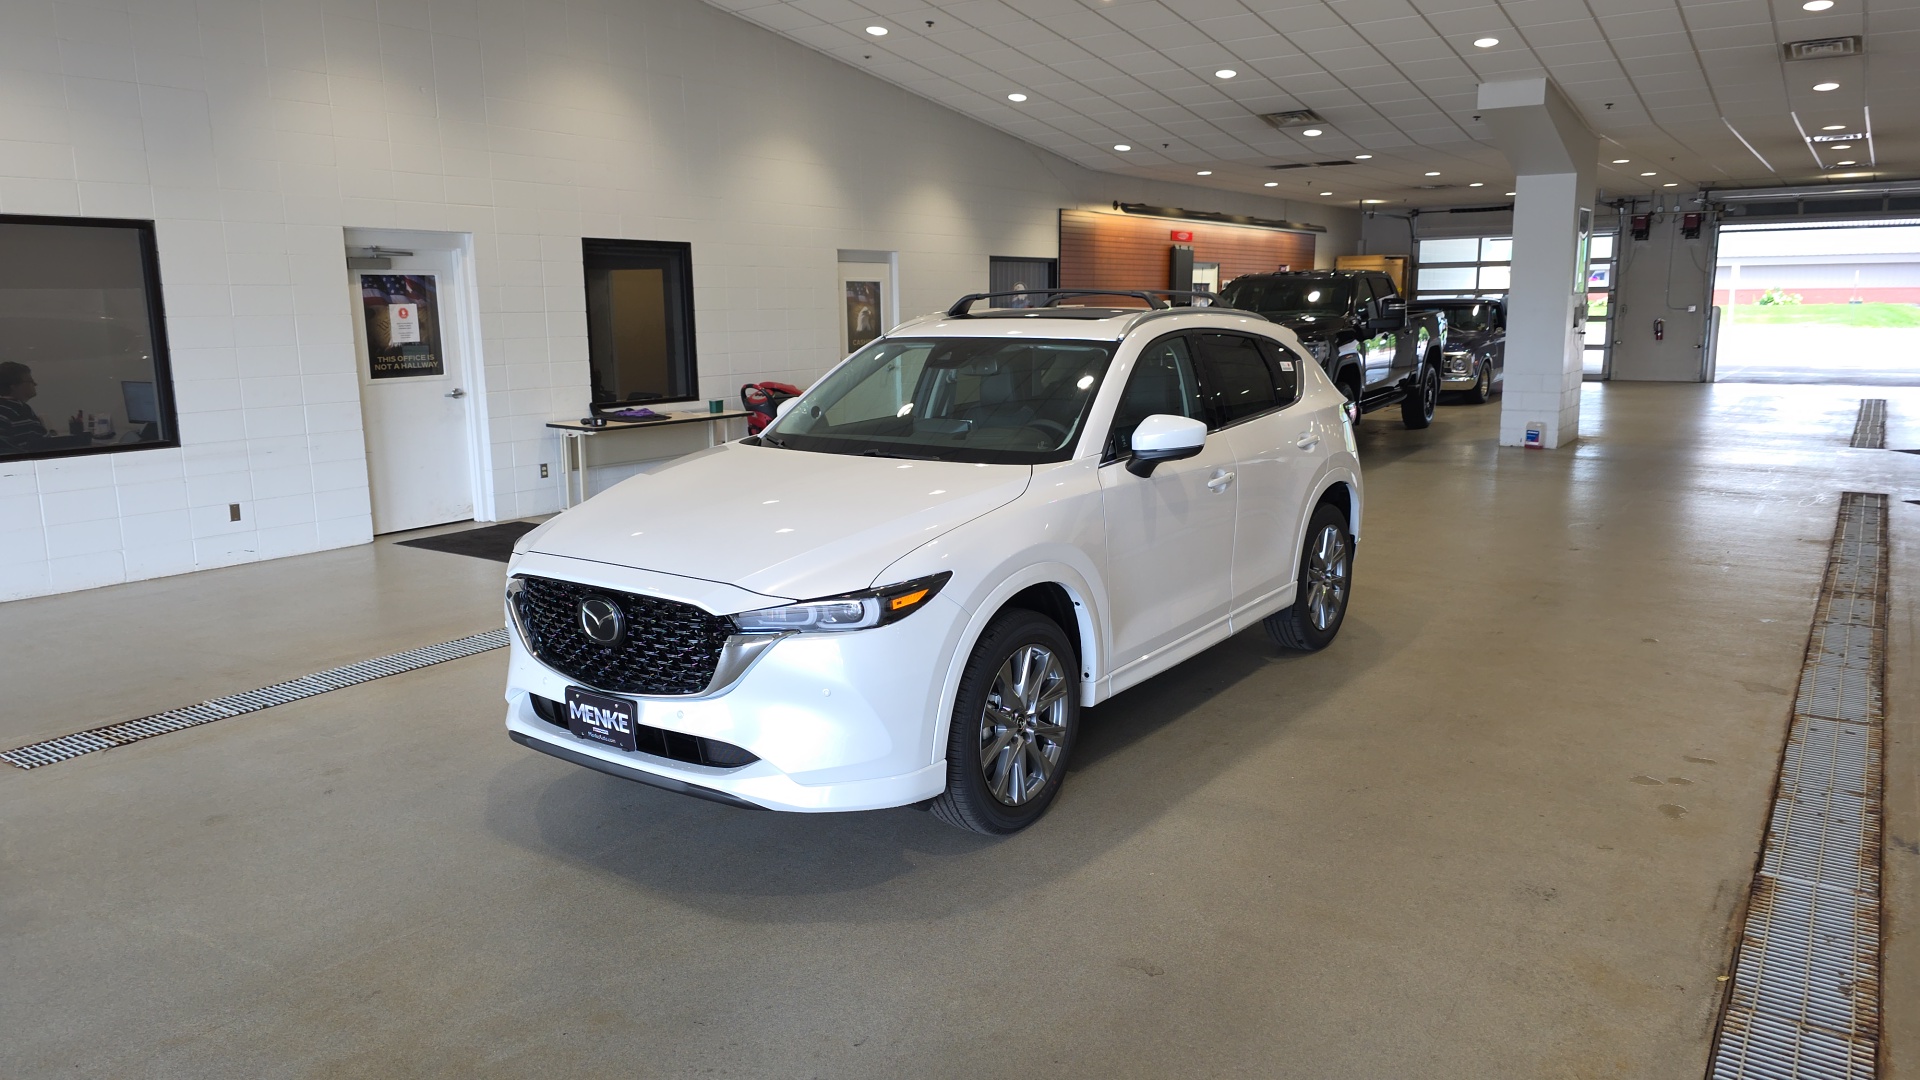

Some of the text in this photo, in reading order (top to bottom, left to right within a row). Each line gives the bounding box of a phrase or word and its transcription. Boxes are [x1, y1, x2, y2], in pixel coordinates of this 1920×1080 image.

[397, 354, 426, 362] OFFICE
[401, 361, 439, 369] HALLWAY
[569, 700, 630, 734] MENKE
